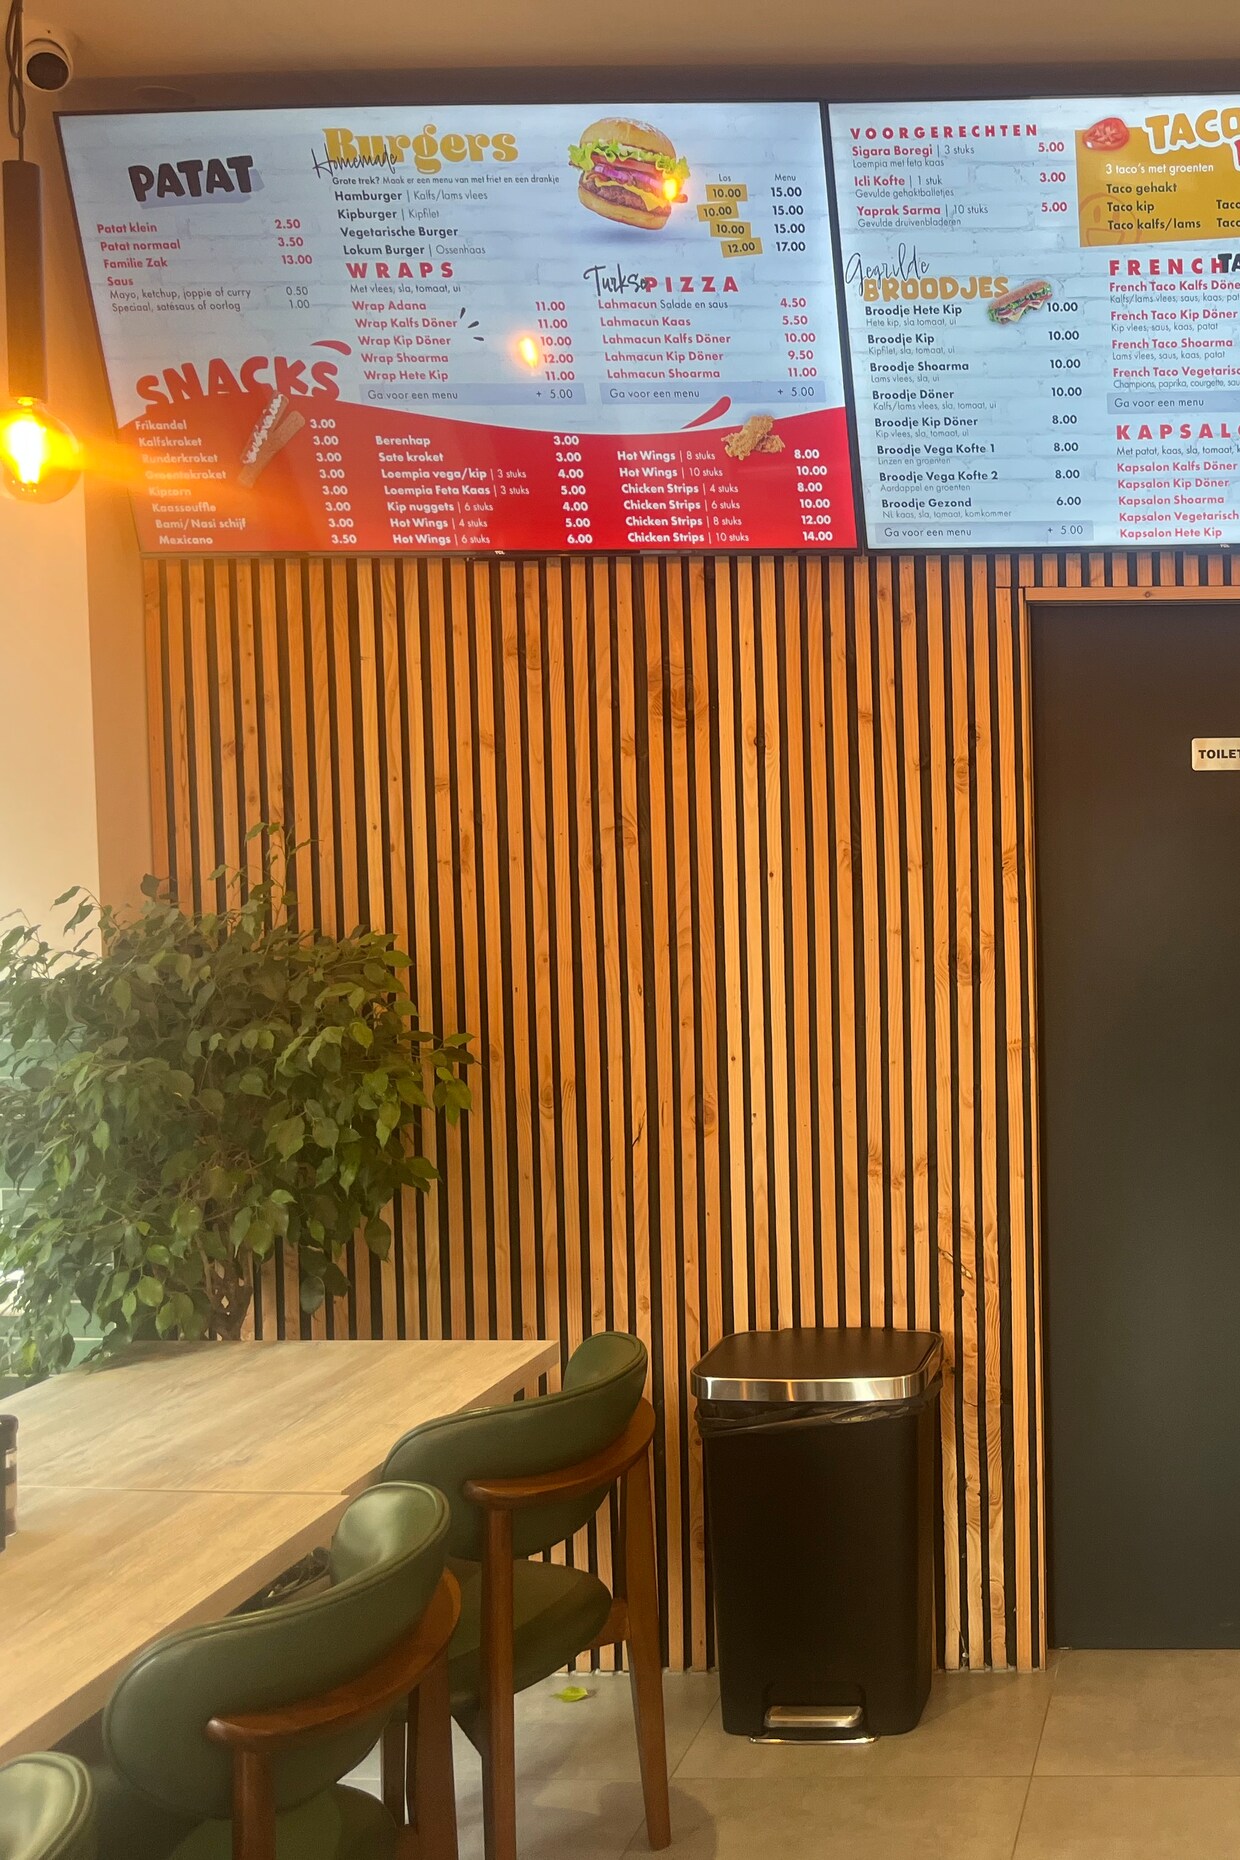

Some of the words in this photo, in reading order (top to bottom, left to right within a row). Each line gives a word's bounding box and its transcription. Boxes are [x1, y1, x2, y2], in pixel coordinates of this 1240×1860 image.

[850, 124, 1037, 140] VOORGERECHTEN
[322, 124, 518, 174] Burgers
[852, 146, 891, 158] Sigara
[894, 145, 933, 157] Boregi
[945, 146, 950, 155] 3
[954, 145, 975, 155] stuks
[1038, 142, 1065, 152] 5.00
[312, 143, 398, 178] Homemade
[1106, 164, 1112, 174] 3
[1116, 163, 1145, 174] taco's
[1148, 164, 1166, 173] met
[1169, 163, 1214, 175] groenten
[128, 155, 254, 202] PATAT
[719, 174, 732, 182] Los
[775, 174, 796, 182] Menu
[855, 177, 870, 186] Icli
[873, 176, 905, 186] Kofte
[918, 176, 921, 185] 1
[926, 176, 942, 185] stuk
[1040, 172, 1066, 182] 3.00
[712, 188, 741, 198] 10.00
[770, 187, 802, 198] 15.00
[1106, 184, 1132, 193] Taco
[1136, 182, 1177, 195] gehakt
[335, 190, 402, 202] Hamburger
[413, 190, 462, 200] Kalfs/lams
[465, 190, 488, 200] vlees
[338, 208, 397, 220] Kipburger
[409, 209, 440, 220] Kipfilet
[1107, 202, 1133, 212] Taco
[1136, 202, 1155, 214] kip
[97, 223, 130, 234] Patat
[132, 222, 157, 233] klein
[275, 219, 300, 230] 2.50
[1108, 221, 1134, 230] Taco
[1137, 219, 1201, 229] kalfs/lams
[727, 242, 755, 254] 12.00
[776, 242, 806, 252] 17.00
[104, 258, 143, 269] Familie
[146, 257, 168, 268] Zak
[281, 254, 312, 265] 13.00
[1109, 258, 1224, 276] FRENCH
[346, 262, 454, 279] WRAPS
[845, 243, 930, 296] Gegrilde
[350, 284, 369, 294] Met
[371, 284, 396, 294] vlees,
[398, 284, 414, 294] sla,
[415, 284, 451, 294] tomaat,
[453, 284, 461, 292] ui
[644, 276, 738, 292] PIZZA
[864, 276, 1009, 301] BROODJES
[352, 301, 385, 312] Wrap
[388, 301, 426, 310] Adana
[536, 301, 565, 312] 11.00
[598, 299, 657, 310] Lahmacun
[660, 300, 692, 310] Salade
[695, 301, 706, 309] en
[780, 298, 806, 308] 4.50
[865, 306, 910, 317] Broodje
[913, 305, 939, 315] Hete
[943, 305, 962, 316] Kip
[1047, 303, 1078, 312] 10.00
[361, 353, 393, 365] Wrap
[396, 353, 448, 363] Shoarma
[543, 354, 573, 364] 12.00
[870, 363, 914, 374] Broodje
[918, 361, 969, 371] Shoarma
[1050, 359, 1080, 369] 10.00
[135, 354, 341, 407] SNACKS
[135, 420, 187, 430] Frikandel
[310, 419, 335, 429] 3.00
[139, 437, 202, 447] Kalfskroket
[375, 436, 431, 448] Berenhap
[554, 436, 579, 446] 3.00
[1117, 447, 1133, 455] Met
[1136, 447, 1159, 456] patat,
[1162, 446, 1183, 455] kaas,
[1186, 446, 1200, 455] sla,
[1202, 446, 1234, 455] tomaat,
[1118, 496, 1171, 506] Kapsalon
[1174, 495, 1224, 505] Shoarma
[159, 535, 213, 545] Mexicano
[331, 535, 357, 544] 3.50
[627, 532, 668, 543] Chicken
[670, 532, 704, 545] Strips
[716, 533, 726, 542] 10
[729, 533, 749, 542] stuks
[802, 532, 833, 542] 14.00
